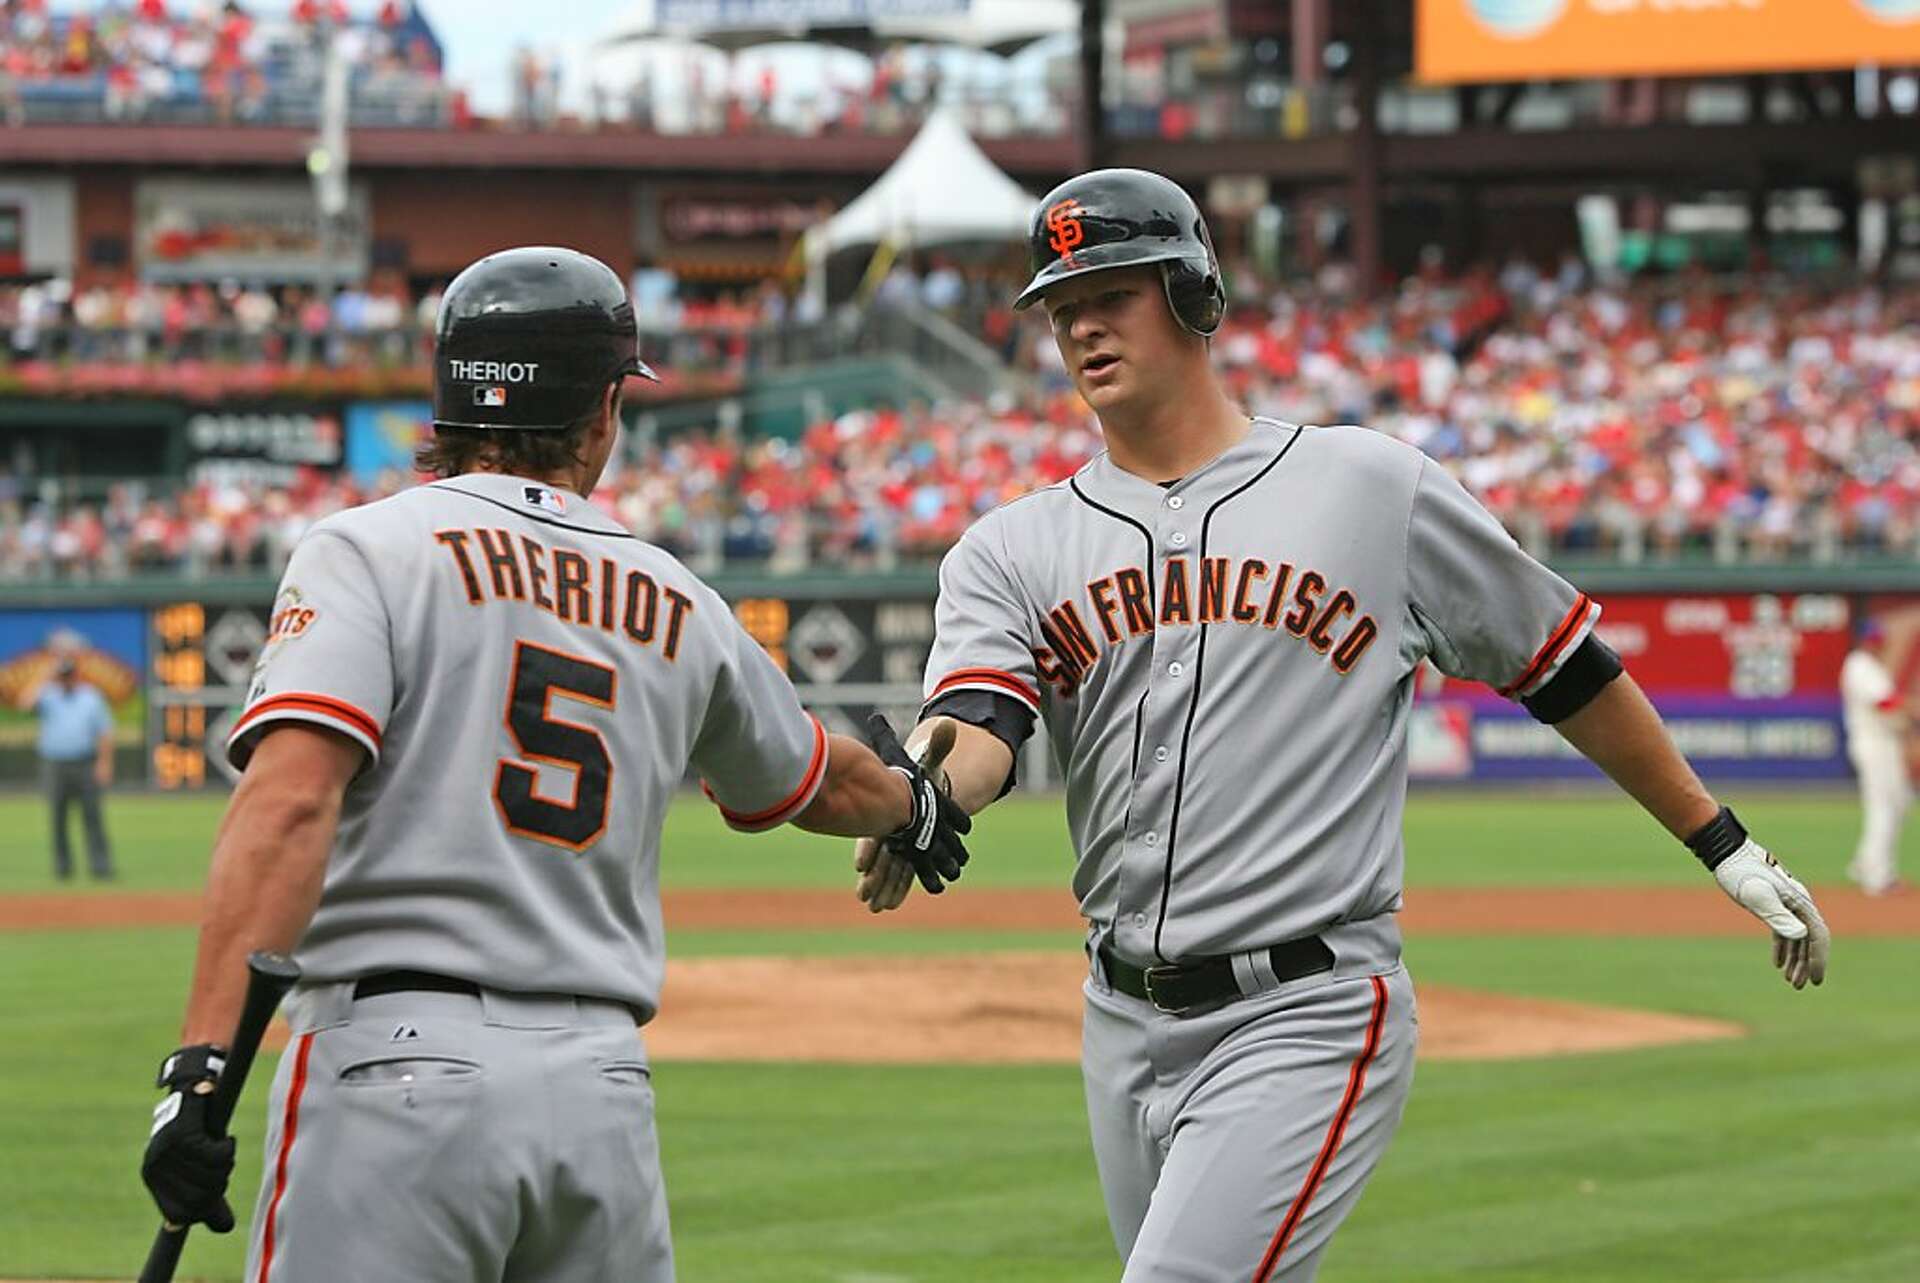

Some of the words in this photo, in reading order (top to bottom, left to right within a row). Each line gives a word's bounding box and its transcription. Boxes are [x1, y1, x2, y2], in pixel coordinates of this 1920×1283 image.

[450, 360, 538, 382] THERIOT
[435, 528, 694, 662] THERIOT
[1036, 600, 1102, 694] SAN
[1087, 556, 1377, 675] FRANCISCO
[493, 639, 618, 853] 5
